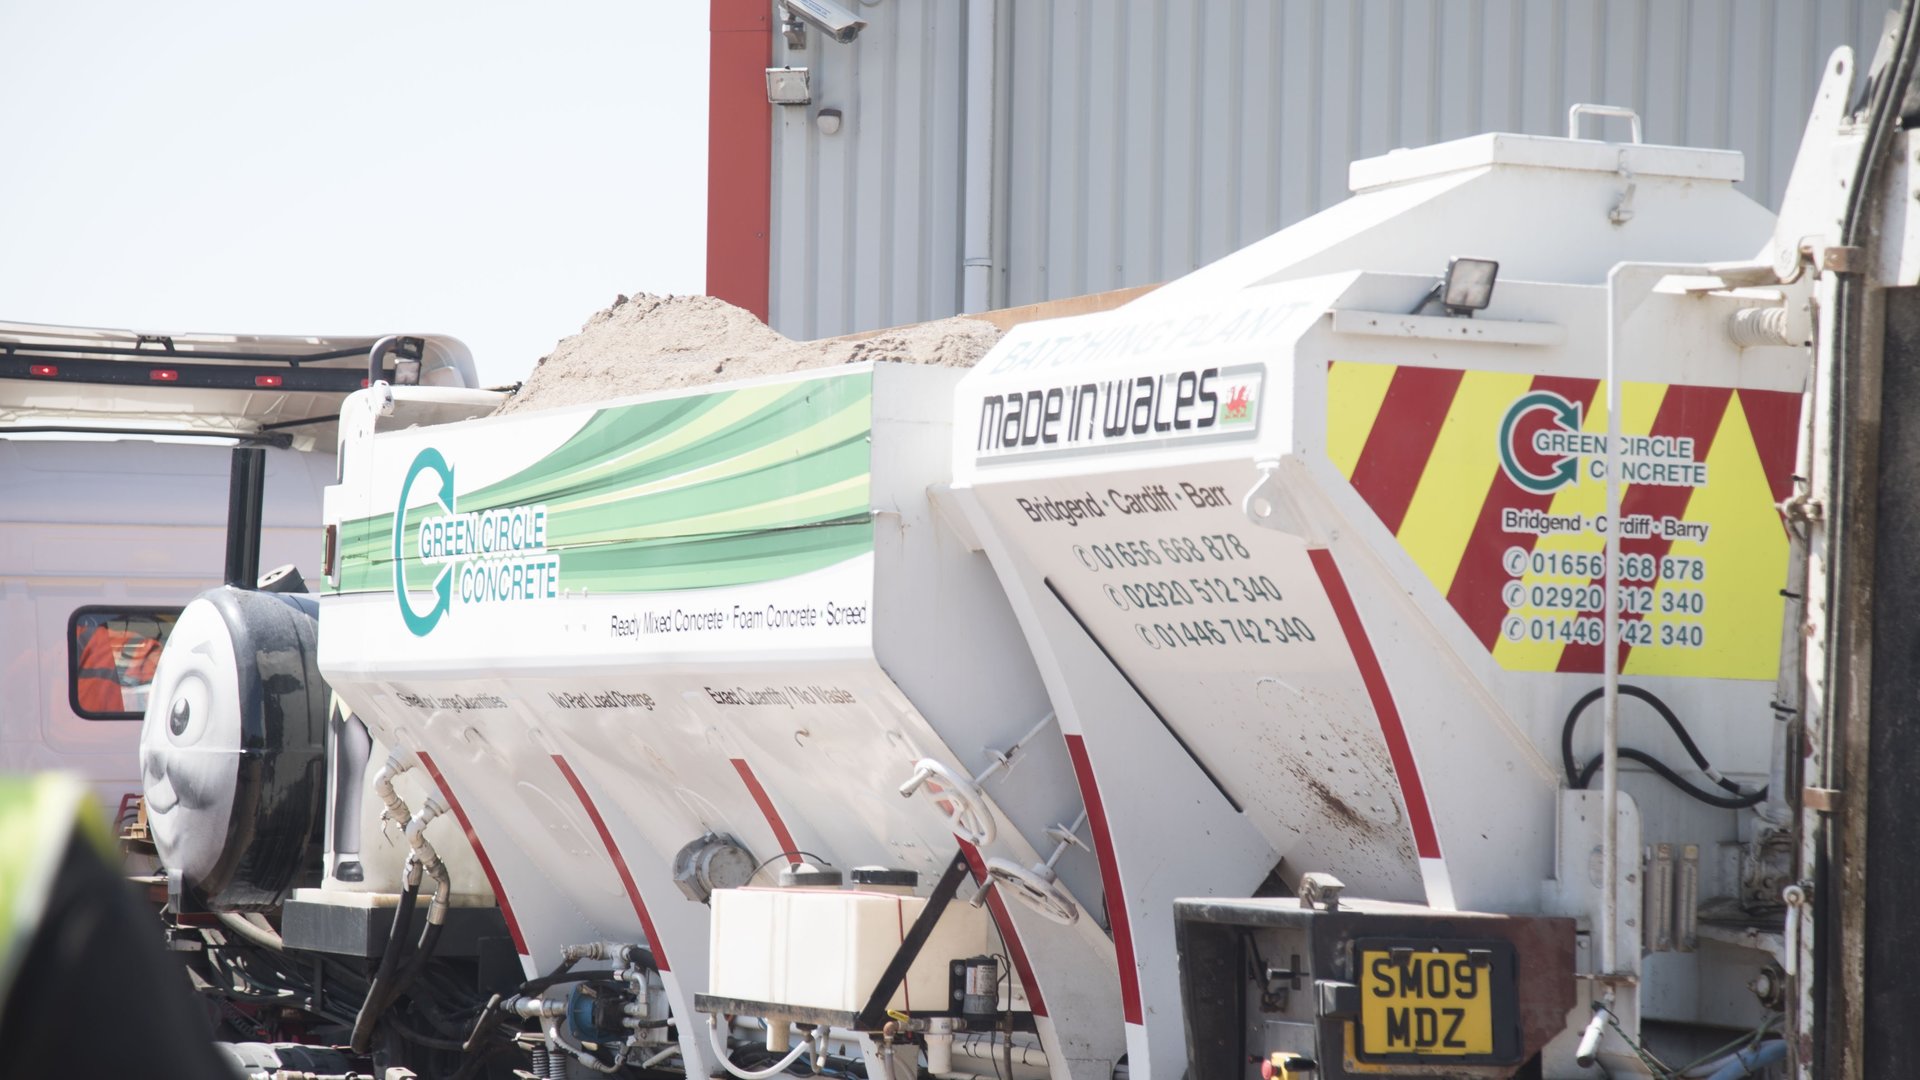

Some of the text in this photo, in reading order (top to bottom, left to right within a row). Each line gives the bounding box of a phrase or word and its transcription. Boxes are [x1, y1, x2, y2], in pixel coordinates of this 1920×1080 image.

[989, 300, 1312, 375] BATCHING PLANT
[1535, 432, 1608, 455] GREEN
[1590, 459, 1706, 484] CNCRETE
[1017, 491, 1107, 527] Bridgend
[1108, 484, 1178, 516] Cardiff
[421, 511, 545, 559] GREEN CIRCLE
[1505, 511, 1709, 542] Bridgend Crdiff Barry
[1091, 533, 1251, 570] 01656 668 878
[1531, 552, 1603, 577] 01656
[1662, 558, 1704, 581] 878
[461, 561, 557, 605] CONCRETE
[1122, 574, 1283, 609] 02920 512 340
[1531, 586, 1602, 610] 02920
[1662, 591, 1704, 614] 340
[610, 600, 867, 641] Ready Mixed Concrete Foam Concrete Screed
[1154, 616, 1317, 649] 01446 742 340
[1530, 618, 1602, 643] 01446
[1662, 624, 1704, 647] 340
[547, 691, 571, 709] No
[611, 690, 656, 711] Charge
[704, 686, 745, 706] Exact
[789, 685, 817, 705] No
[807, 685, 857, 705] Waste
[1371, 958, 1478, 999] SM09
[1386, 1006, 1467, 1049] MDZ
